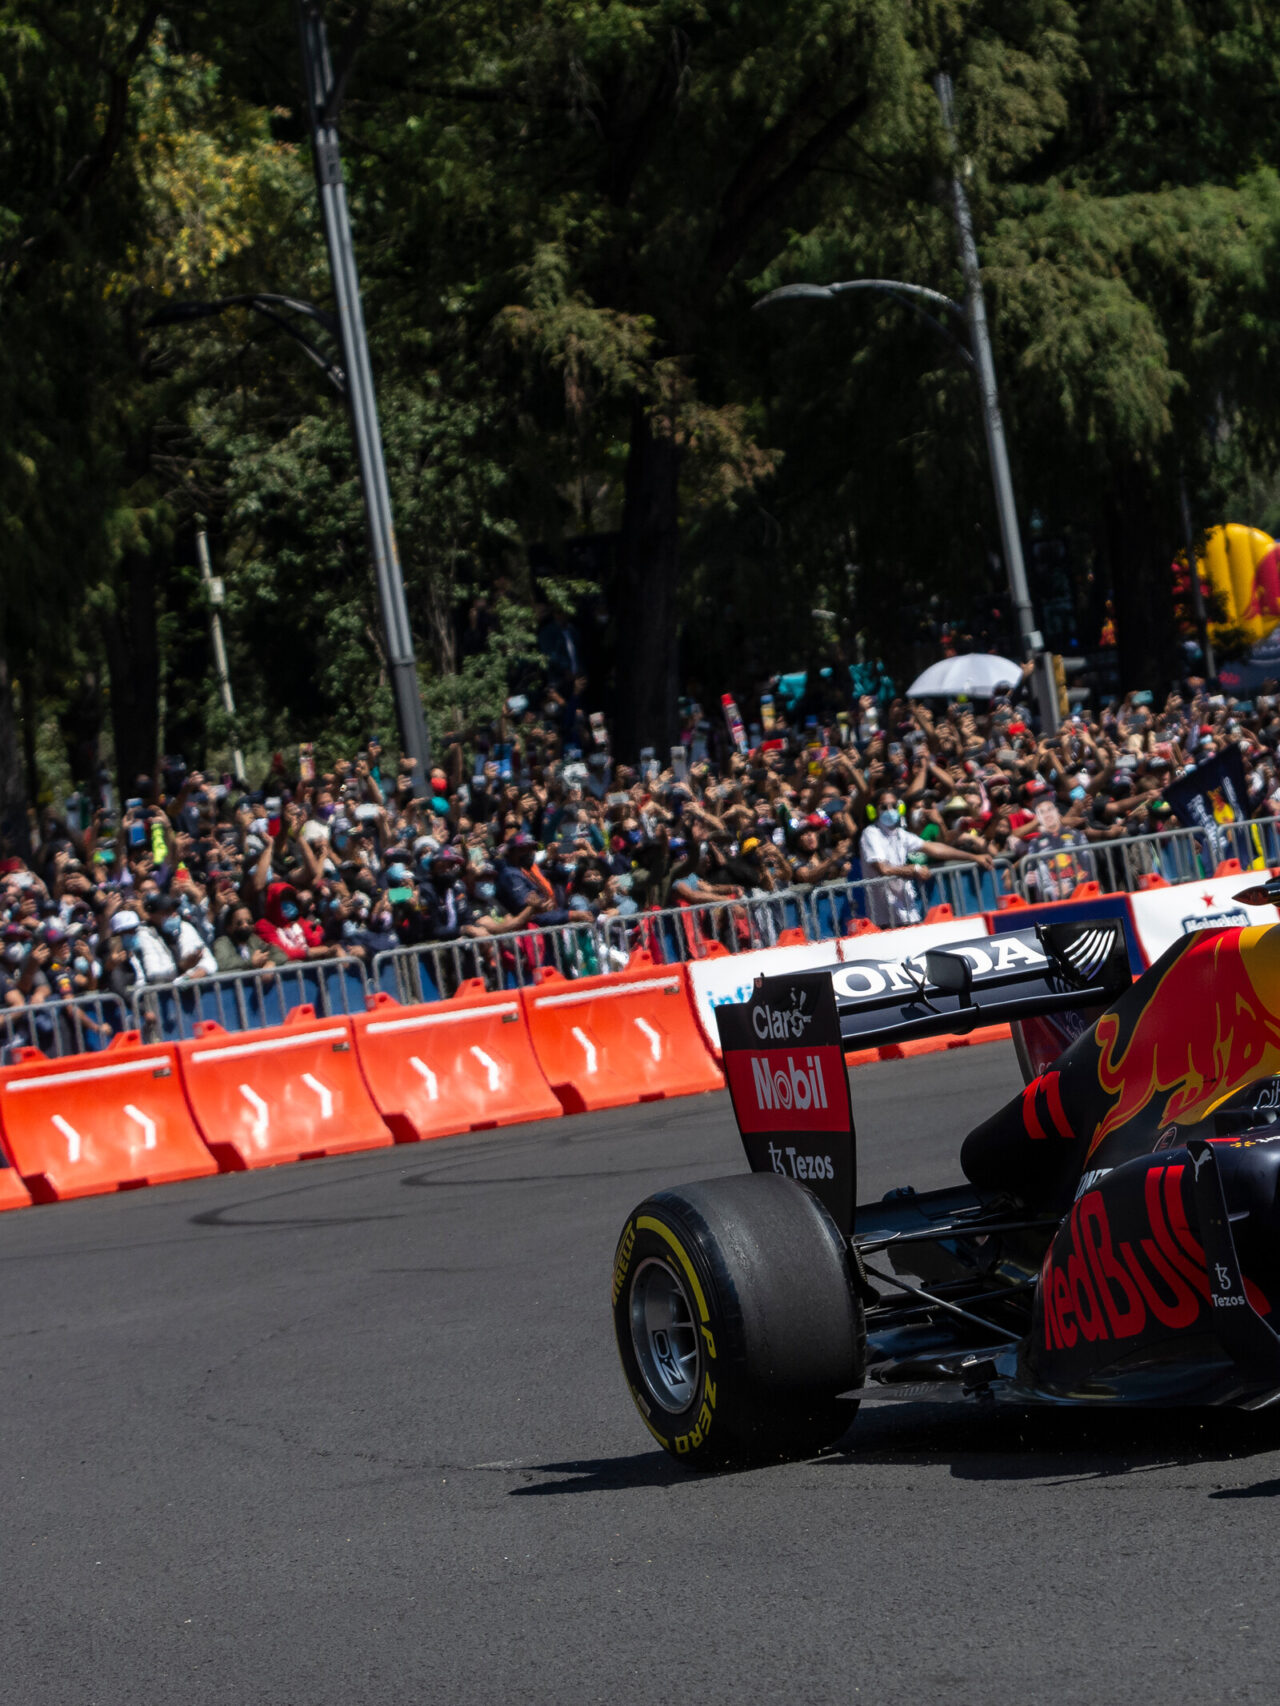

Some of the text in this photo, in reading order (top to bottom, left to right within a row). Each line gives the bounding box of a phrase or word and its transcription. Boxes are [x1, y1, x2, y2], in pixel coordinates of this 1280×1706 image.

[752, 996, 812, 1040] Claro
[751, 1055, 829, 1111] Mobil
[1022, 1070, 1077, 1140] 11
[786, 1146, 835, 1180] Tezos
[1212, 1293, 1246, 1308] Tezos
[675, 1325, 718, 1455] P ZERO
